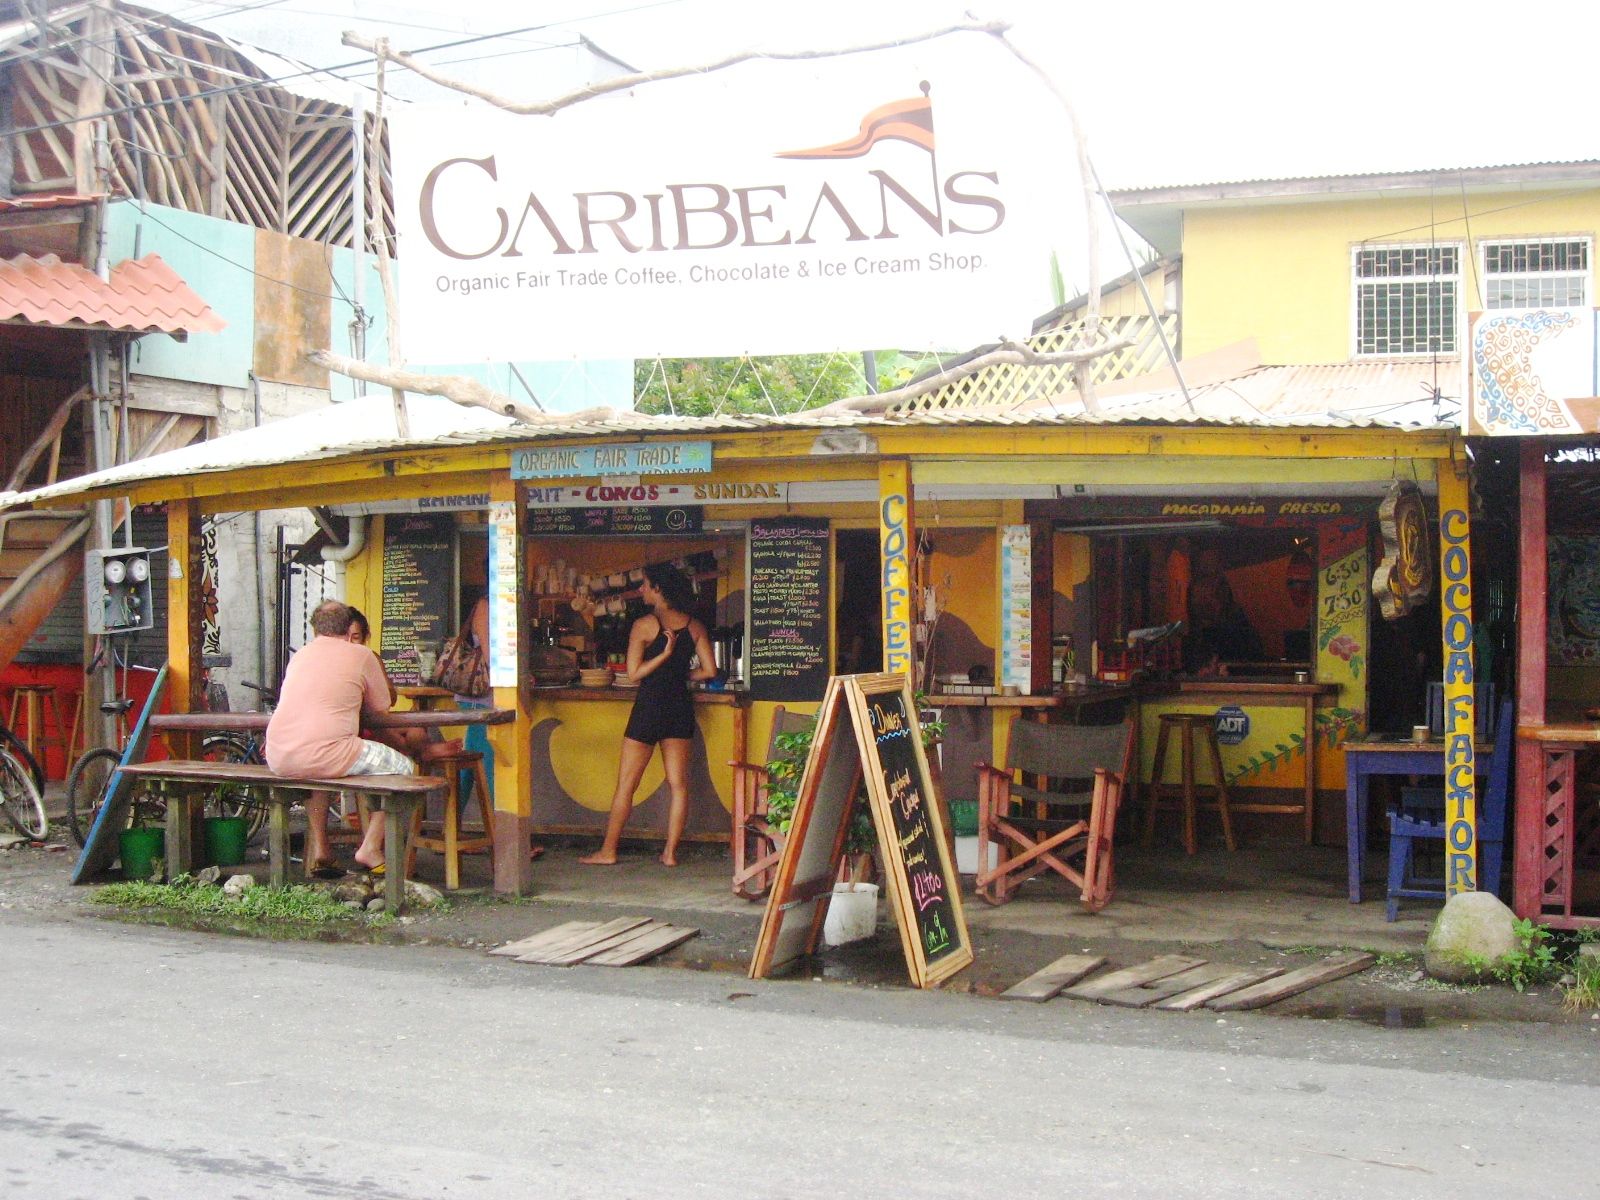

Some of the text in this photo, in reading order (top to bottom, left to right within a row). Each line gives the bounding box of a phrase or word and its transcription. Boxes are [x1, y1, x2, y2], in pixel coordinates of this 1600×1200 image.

[419, 155, 1005, 260] CARIBEANS
[436, 273, 510, 295] Organic
[516, 270, 550, 288] Fair
[556, 268, 608, 286] Trade
[689, 262, 790, 283] Chocolate
[797, 260, 810, 277] &
[818, 258, 847, 276] Ice
[854, 256, 921, 275] Cream
[519, 445, 681, 472] ORGANIC FAIR TRADE
[585, 485, 660, 502] CONOS
[1279, 502, 1342, 514] FRESCA
[1440, 509, 1477, 897] COCOA FACTOR
[1216, 717, 1246, 733] ADT
